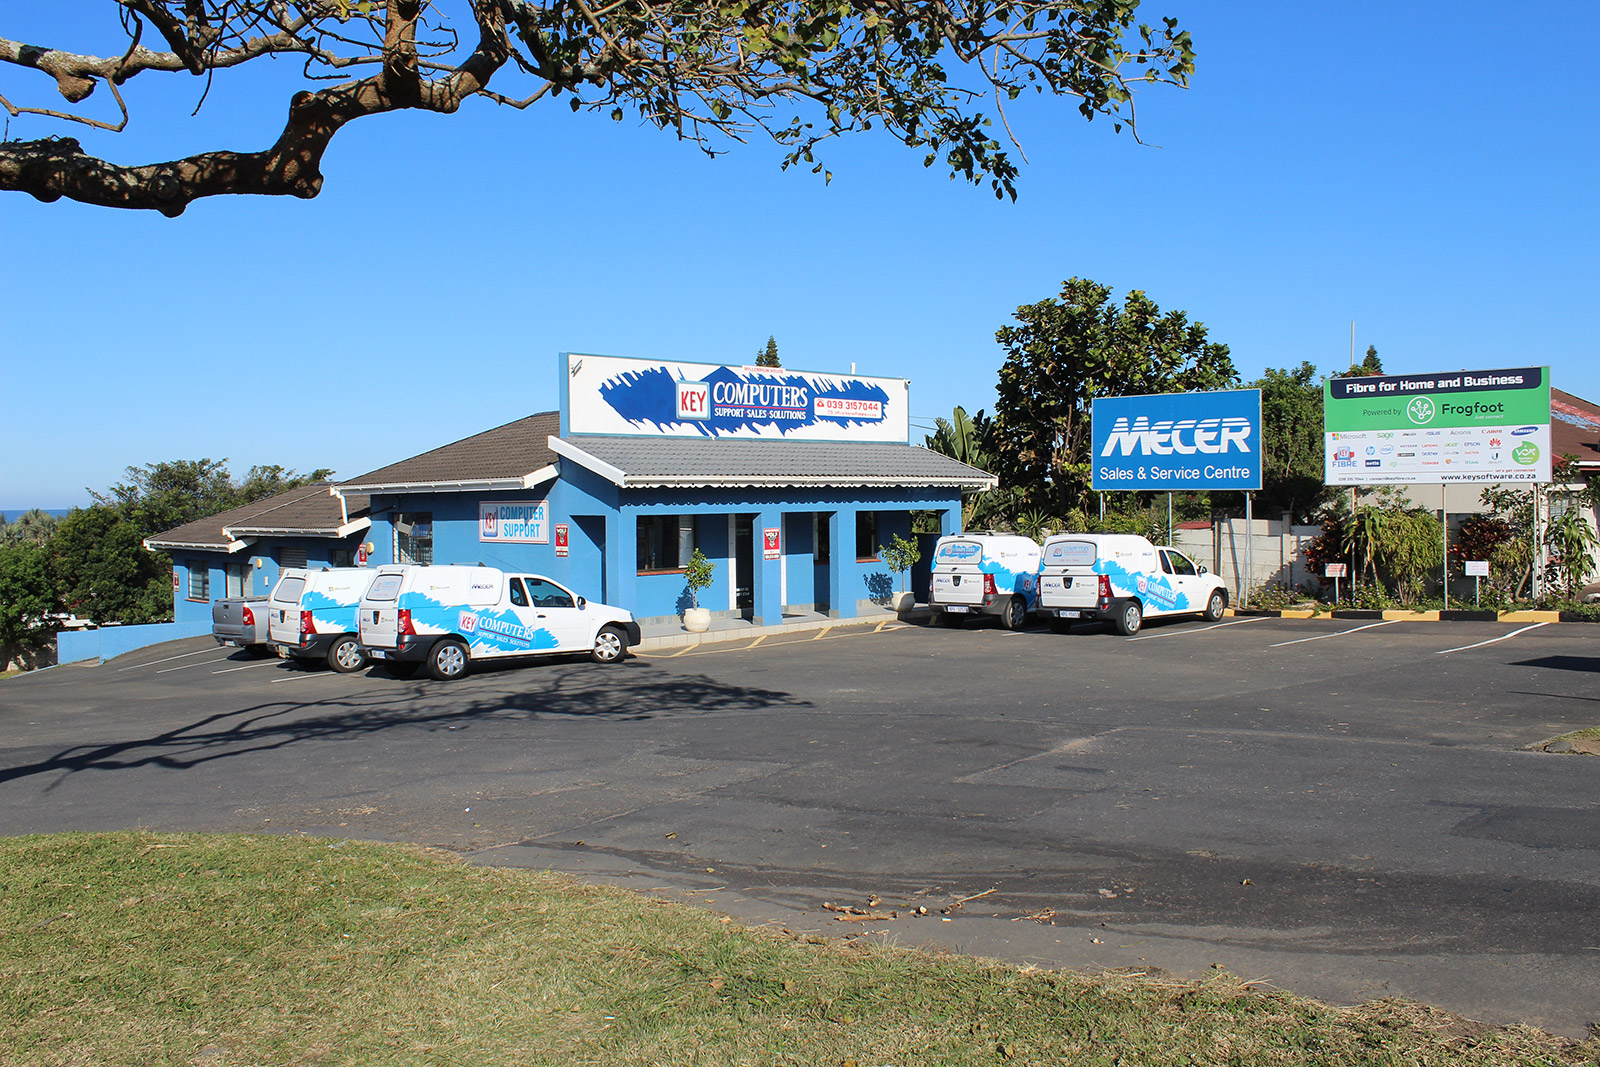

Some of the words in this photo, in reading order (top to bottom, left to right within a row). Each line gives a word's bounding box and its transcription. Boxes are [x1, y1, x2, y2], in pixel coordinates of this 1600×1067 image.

[1346, 384, 1376, 393] Fibre
[1378, 382, 1397, 391] for
[1400, 380, 1434, 390] Home
[1437, 378, 1461, 388] and
[1464, 375, 1524, 387] Business
[681, 390, 707, 412] KEY
[713, 381, 808, 408] COMPUTERS
[827, 400, 843, 409] 039
[845, 401, 879, 411] 3157044
[1393, 408, 1402, 416] by
[1442, 402, 1504, 416] Frogfoot
[714, 407, 745, 418] SUPPORT
[746, 409, 767, 419] SALES
[769, 411, 807, 420] SOLUTIONS
[1100, 416, 1251, 457] MECER
[1332, 460, 1358, 468] FIBRE
[1100, 467, 1134, 480] Sales
[1137, 467, 1147, 480] &
[1150, 466, 1201, 480] Service
[1204, 465, 1250, 479] Centre
[485, 511, 497, 530] KEY
[500, 506, 544, 520] COMPUTER
[504, 523, 541, 537] SUPPORT
[461, 615, 476, 631] KEY
[479, 616, 534, 640] COMPUTERS
